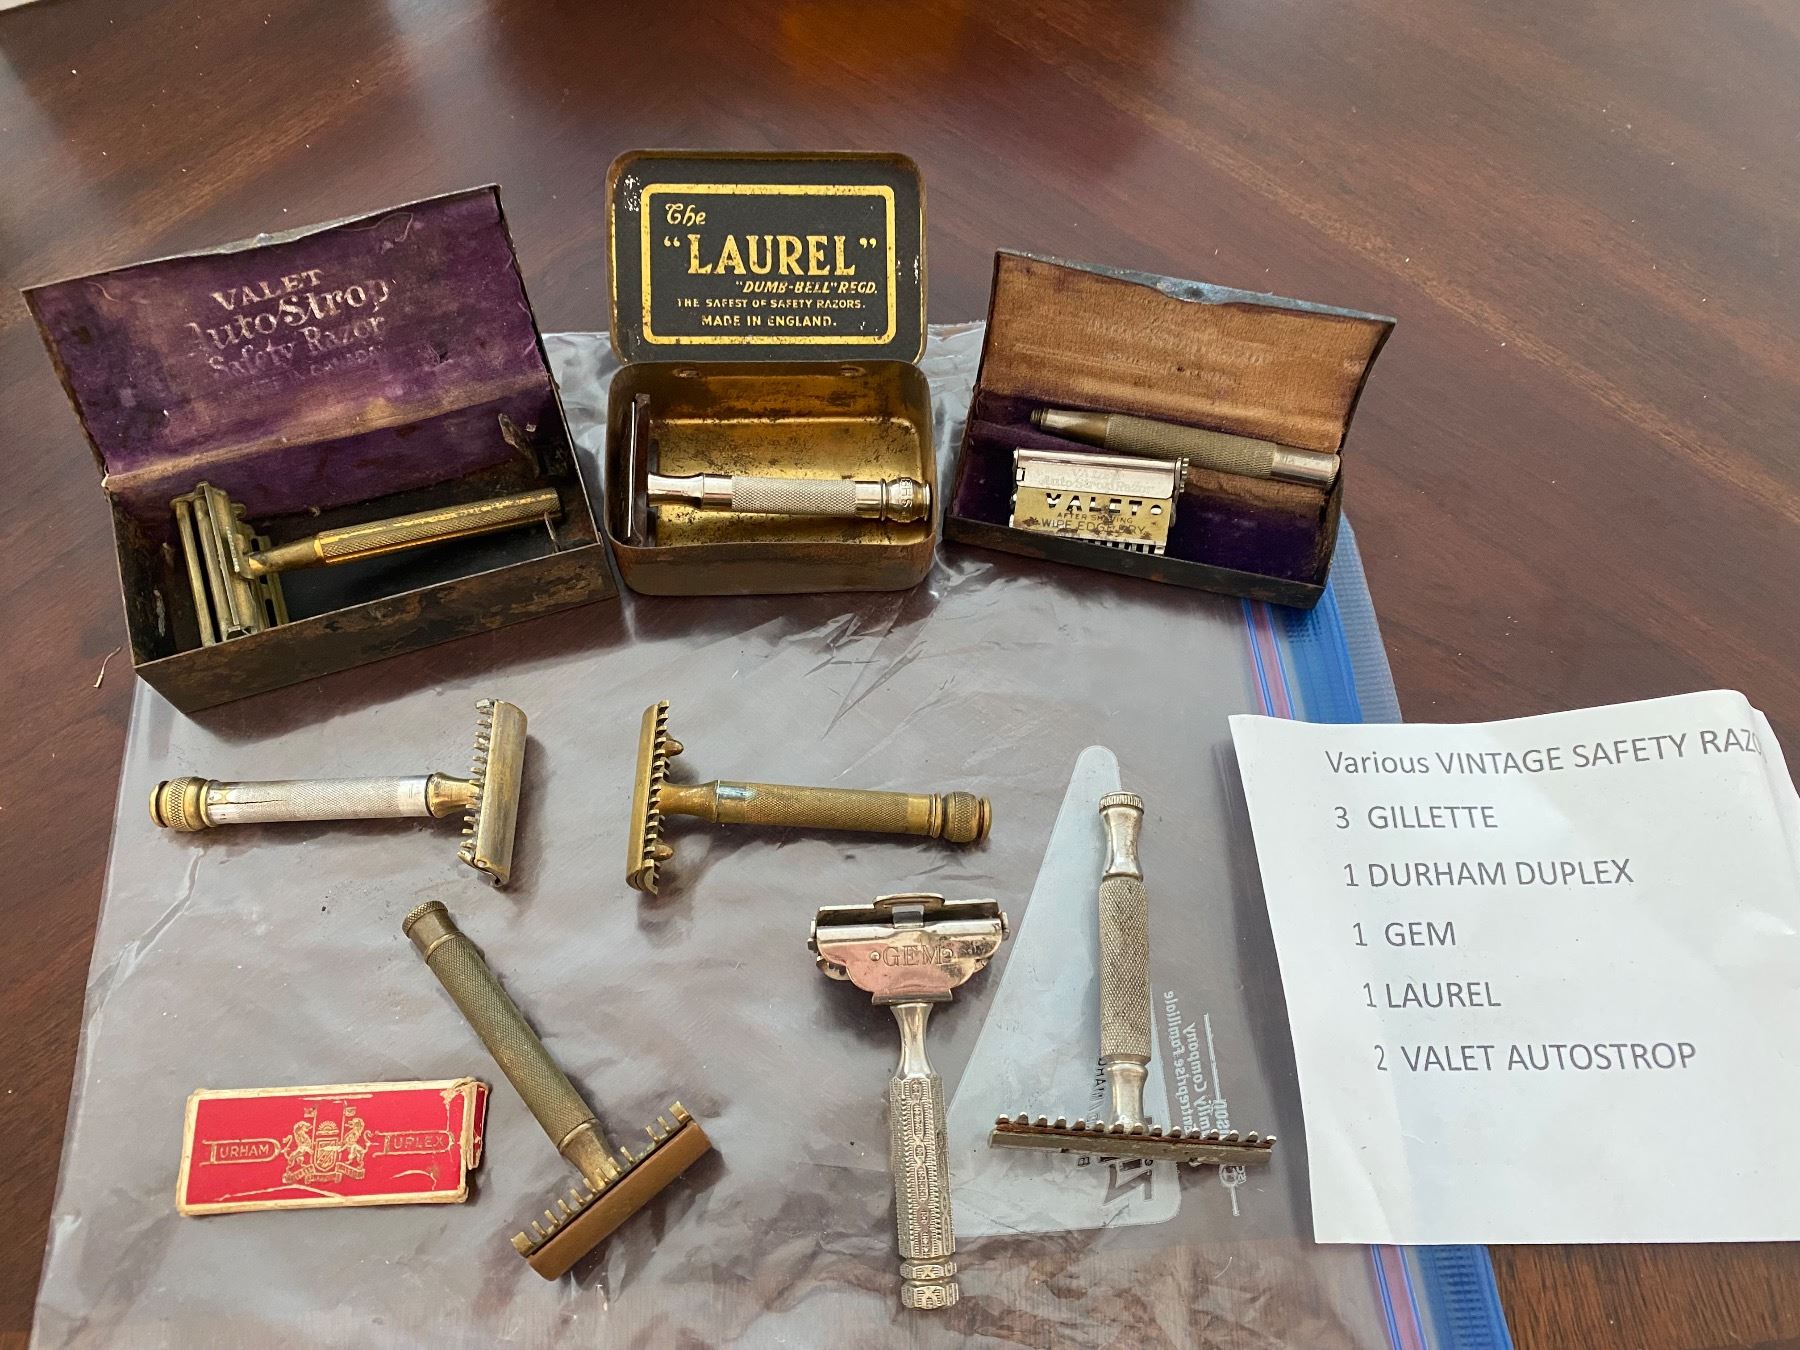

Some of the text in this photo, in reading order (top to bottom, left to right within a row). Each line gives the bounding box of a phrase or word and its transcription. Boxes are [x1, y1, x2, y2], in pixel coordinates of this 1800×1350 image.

[665, 203, 706, 227] The
[210, 269, 323, 310] VALET
[706, 299, 748, 308] SAFEST
[752, 299, 767, 308] OF
[770, 299, 813, 309] SAFETY
[816, 300, 866, 309] RAZORS.
[701, 315, 837, 327] MADE IN ENGLAND.
[1046, 493, 1142, 516] VALET
[1041, 518, 1073, 529] WIPE
[1078, 521, 1113, 533] EDGE
[1057, 512, 1133, 524] AFTER SHVING
[1325, 750, 1430, 775] Various
[1435, 747, 1562, 775] VINTAGE
[1572, 732, 1687, 769] SAFETY
[1335, 806, 1498, 830] 3 GILLETTE
[1344, 858, 1635, 888] 1 DURHAM DUPLEX
[1354, 921, 1457, 947] 1 GEM
[882, 944, 943, 967] GEM
[1363, 982, 1502, 1009] 1 LAUREL
[1375, 1041, 1697, 1072] 2 VALET AUTOSTROP
